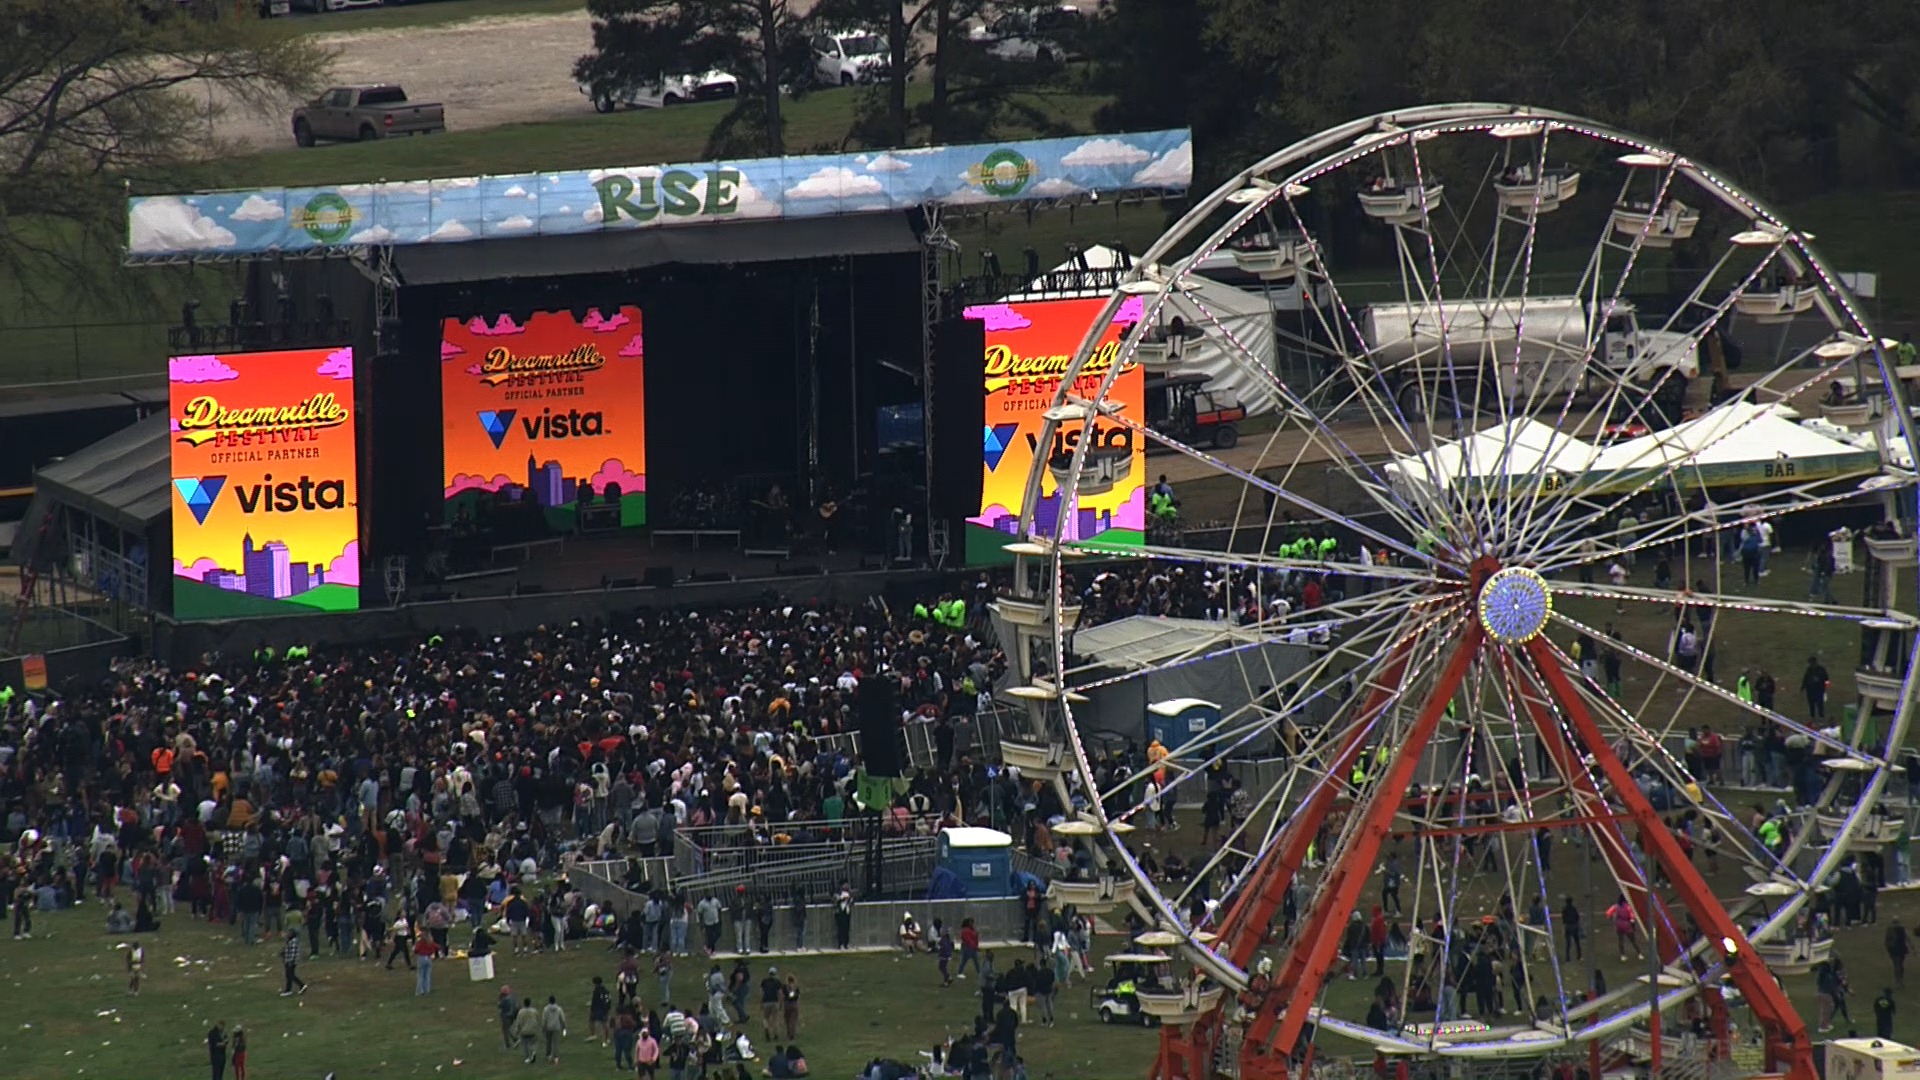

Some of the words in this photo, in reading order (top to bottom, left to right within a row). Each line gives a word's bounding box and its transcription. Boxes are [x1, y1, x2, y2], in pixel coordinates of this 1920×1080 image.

[591, 169, 741, 223] RISE
[482, 343, 606, 374] Dreamville
[985, 340, 1136, 377] Dreamill
[504, 390, 543, 401] OFFICIAL
[546, 386, 585, 398] PARTNER
[179, 392, 349, 431] Dreamville
[214, 427, 319, 448] FESTIVAL
[210, 450, 263, 464] OFFICIAL
[267, 447, 320, 461] PARTNER
[1764, 462, 1795, 477] BAR
